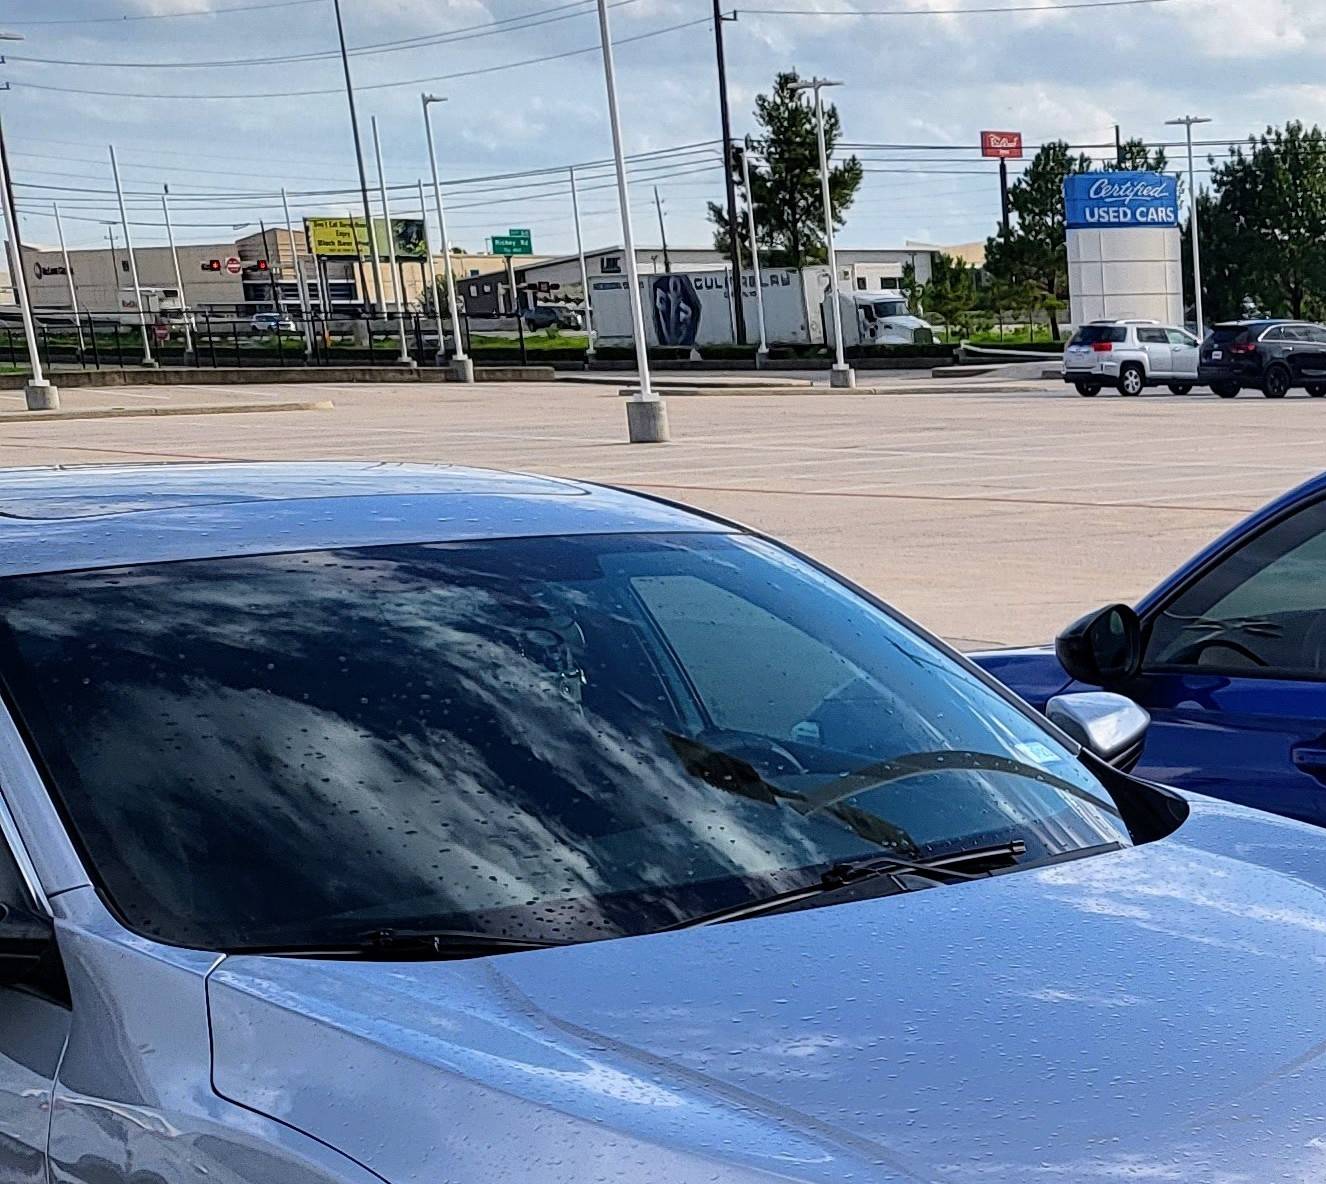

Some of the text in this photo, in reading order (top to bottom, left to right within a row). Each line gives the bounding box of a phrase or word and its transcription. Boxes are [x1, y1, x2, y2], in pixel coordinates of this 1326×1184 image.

[1089, 178, 1169, 205] Certified
[1085, 207, 1174, 223] USED CARS
